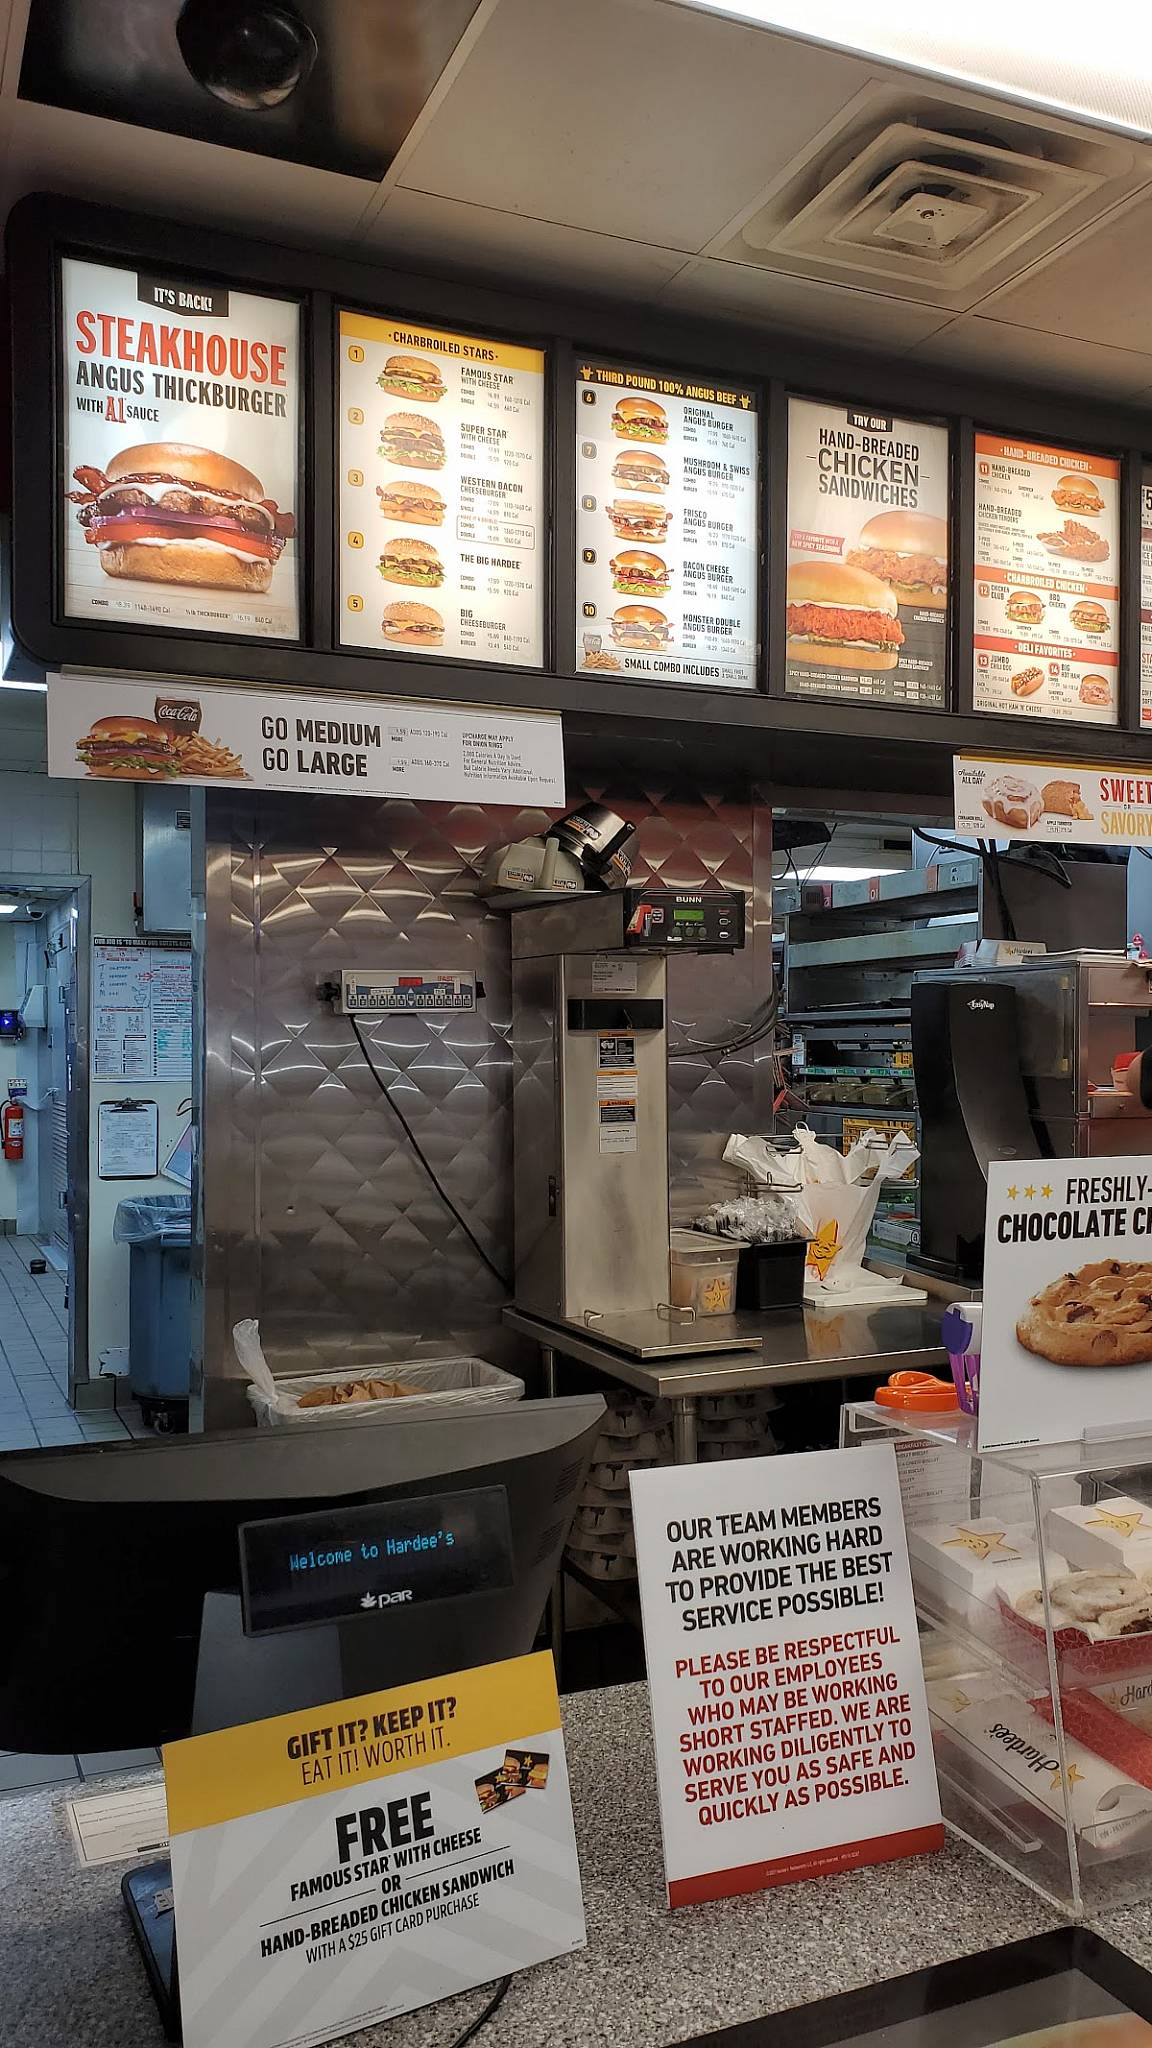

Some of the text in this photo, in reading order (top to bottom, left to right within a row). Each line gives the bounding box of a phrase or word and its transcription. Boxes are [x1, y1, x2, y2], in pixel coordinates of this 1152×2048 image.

[154, 287, 212, 312] IT'S BACK!
[75, 310, 287, 386] STEAKHOUSE
[394, 331, 494, 361] CHARBROILED STARS
[461, 367, 514, 384] FAMOUS STAR
[461, 377, 500, 390] WITH CHEESE
[596, 369, 737, 405] THIRD POUND 100% ANGUS BEEF
[76, 360, 287, 418] ANGUS THICKBURGER
[77, 397, 103, 413] WITH
[127, 405, 159, 422] SAUCE
[684, 406, 714, 419] ORIGINAL
[461, 423, 507, 439] SUPER STAR
[683, 415, 733, 431] ANGUS BURGER
[853, 414, 887, 431] TRY OUR
[461, 433, 500, 446] WITH CHEESE
[819, 428, 919, 461] HAND-BREADED
[684, 457, 720, 470] MUSHROOM
[730, 465, 750, 475] SWISS
[818, 448, 919, 487] CHICKEN
[992, 464, 1031, 477] HAND-BREADED
[1004, 446, 1089, 471] HAND-BREADED CHICKEN
[461, 476, 523, 493] WESTERN BACON
[684, 466, 733, 481] ANGUS BURGER
[992, 472, 1011, 481] CHICKEN
[461, 485, 506, 499] CHEESEBURGER
[819, 474, 918, 508] SANDWICHES
[684, 509, 707, 519] FRISCO
[684, 517, 733, 532] ANGUS BURGER
[460, 554, 520, 570] THE BIG HARDEE
[683, 561, 729, 574] BACON CHEESE
[683, 570, 733, 584] ANGUS BURGER
[1007, 571, 1085, 593] CHARBROILED CHICKEN
[460, 609, 473, 618] BIG
[461, 618, 506, 631] CHEESEBURGER
[683, 614, 741, 628] MONSTER DOUBLE
[683, 622, 732, 636] ANGUS BURGER
[1018, 643, 1073, 658] DELI FAVORITES
[625, 658, 651, 671] SMALL
[654, 660, 681, 673] COMBO
[682, 663, 720, 678] INCLUDES
[158, 705, 199, 722] Coca-Cola
[261, 716, 381, 747] GO MEDIUM
[263, 748, 367, 777] GO LARGE
[974, 777, 983, 785] DAY
[1100, 778, 1152, 804] SWEET
[998, 1208, 1126, 1243] CHOCOLATE
[667, 1497, 881, 1543] OUR TEAM MEMBERS
[290, 1531, 455, 1571] Welcome to Hardee's
[672, 1525, 883, 1573] ARE WORKING HARD
[665, 1552, 893, 1603] TO PROVIDE THE BEST
[682, 1582, 884, 1631] SERVICE POSSIBLE!
[676, 1626, 900, 1678] PLEASE BE RESPECTFUL
[700, 1652, 882, 1699] TO OUR EMPLOYEES
[688, 1673, 898, 1726] WHO MAY BE WORKING
[287, 1696, 457, 1760] GIFT IT? KEEP IT?
[680, 1694, 911, 1752] SHORT STAFFED. WE ARE
[301, 1726, 451, 1786] EAT IT! WORTH IT.
[683, 1718, 912, 1777] WORKING DILIGENTLY TO
[989, 1723, 1060, 1773] Hardee's
[684, 1741, 916, 1803] SERVE YOU AS SAFE AND
[699, 1768, 909, 1826] QUICKLY AS POSSIBLE.
[335, 1791, 435, 1864] FREE
[290, 1827, 482, 1902] FAMOUS STAR WITH CHEESE
[381, 1874, 402, 1896] OR
[260, 1859, 515, 1958] HAND-BREADED CHICKEN SANDWICH
[305, 1893, 480, 1964] WITH A $25 GIFT CARD PURCHASE
